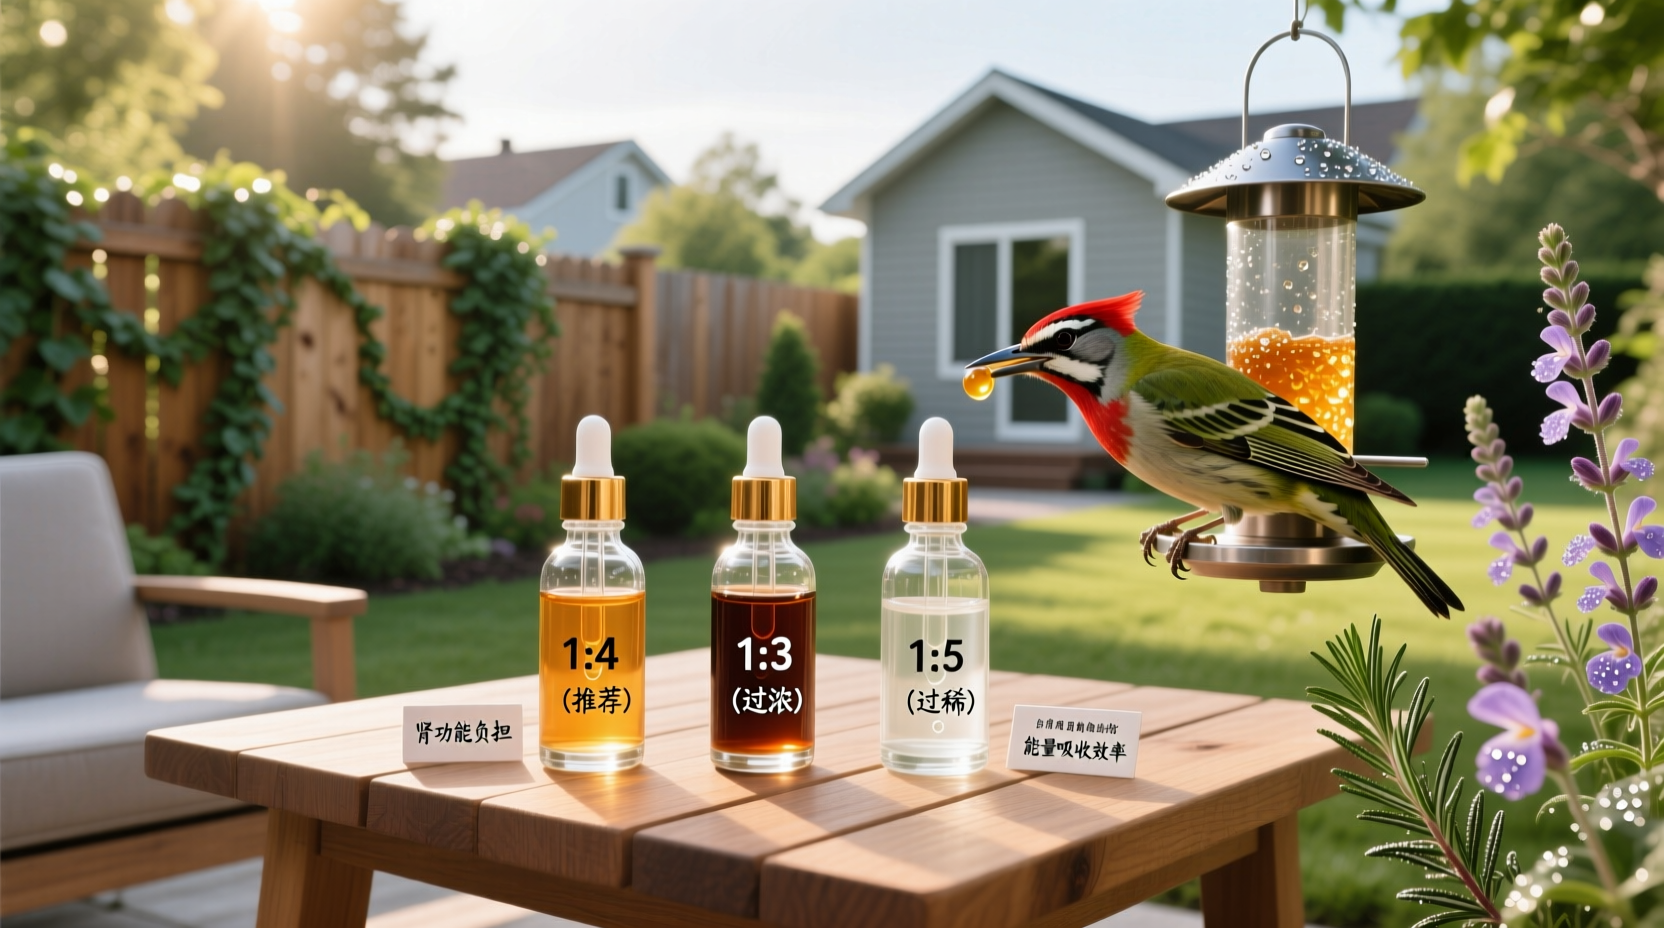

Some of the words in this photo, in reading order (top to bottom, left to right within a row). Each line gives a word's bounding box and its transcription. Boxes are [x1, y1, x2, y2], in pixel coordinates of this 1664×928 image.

[563, 636, 619, 670] 1:4
[737, 636, 793, 671] 1:3
[909, 638, 964, 673] 1:5
[563, 686, 631, 715] (推荐)
[732, 686, 803, 715] (过浓)
[907, 687, 975, 717] (过稀)
[416, 719, 513, 745] 肾功能负担
[1023, 735, 1127, 763] 能量吸收效率
